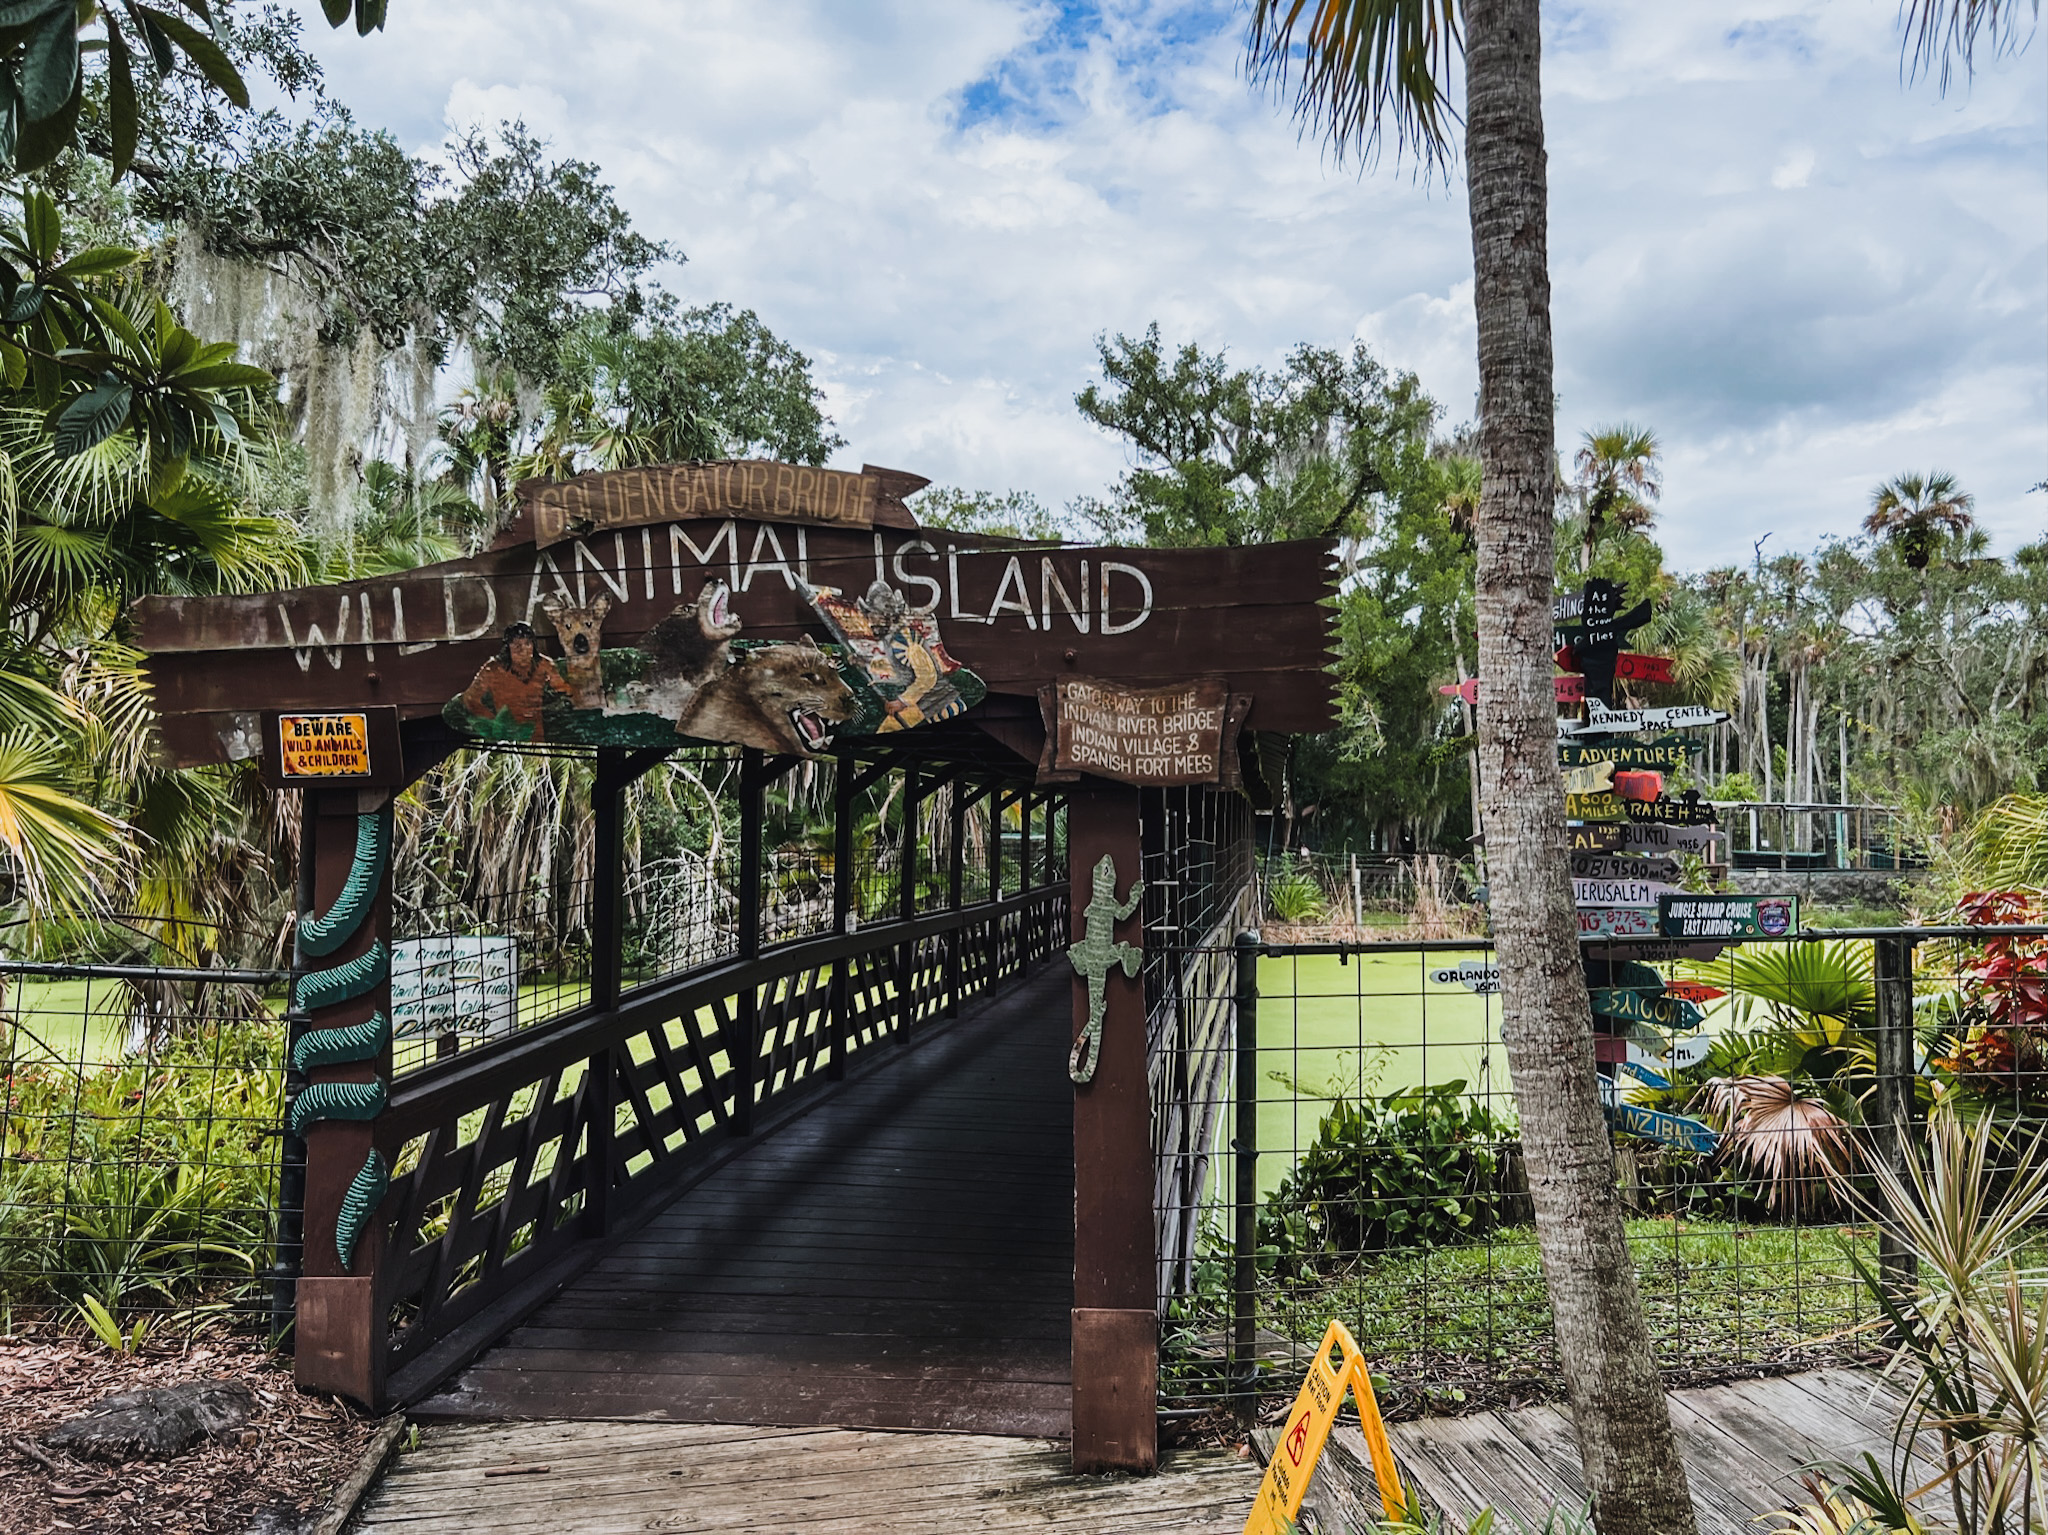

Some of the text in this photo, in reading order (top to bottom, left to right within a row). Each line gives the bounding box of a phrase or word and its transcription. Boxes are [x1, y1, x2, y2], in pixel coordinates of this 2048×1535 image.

[671, 463, 768, 513] GATOR
[774, 464, 878, 524] BRIDGE
[278, 520, 1154, 673] WILD ANIMAL ISLAND
[1592, 591, 1608, 602] As
[1588, 605, 1607, 615] the
[1589, 631, 1614, 645] Flies
[1150, 697, 1166, 715] TO
[1171, 691, 1197, 713] THE
[1588, 699, 1601, 707] 20
[1592, 707, 1711, 726] KENNEDY CENTER
[294, 721, 353, 737] BEWARE
[1117, 716, 1159, 736] RIVER
[1640, 720, 1674, 731] SPACE
[287, 738, 362, 752] WILD ANIMALS
[1071, 723, 1200, 756] INDIAN VILLAGE &
[1070, 744, 1213, 777] SPANISH FORT MEES
[1579, 745, 1687, 765] ADVENTURES
[1581, 793, 1612, 806] 600
[1581, 804, 1618, 819] MILES
[1677, 838, 1699, 850] 4956
[1611, 859, 1648, 877] 9500
[1575, 882, 1649, 903] JERUSALEM
[1668, 902, 1696, 918] JUNGLE
[1697, 902, 1725, 918] SWAMP
[1726, 902, 1752, 918] CRUISE
[1682, 919, 1701, 935] EAST
[1701, 919, 1733, 935] LANDING
[1438, 969, 1500, 983] ORLANDO
[1602, 990, 1678, 1024] SAIGON
